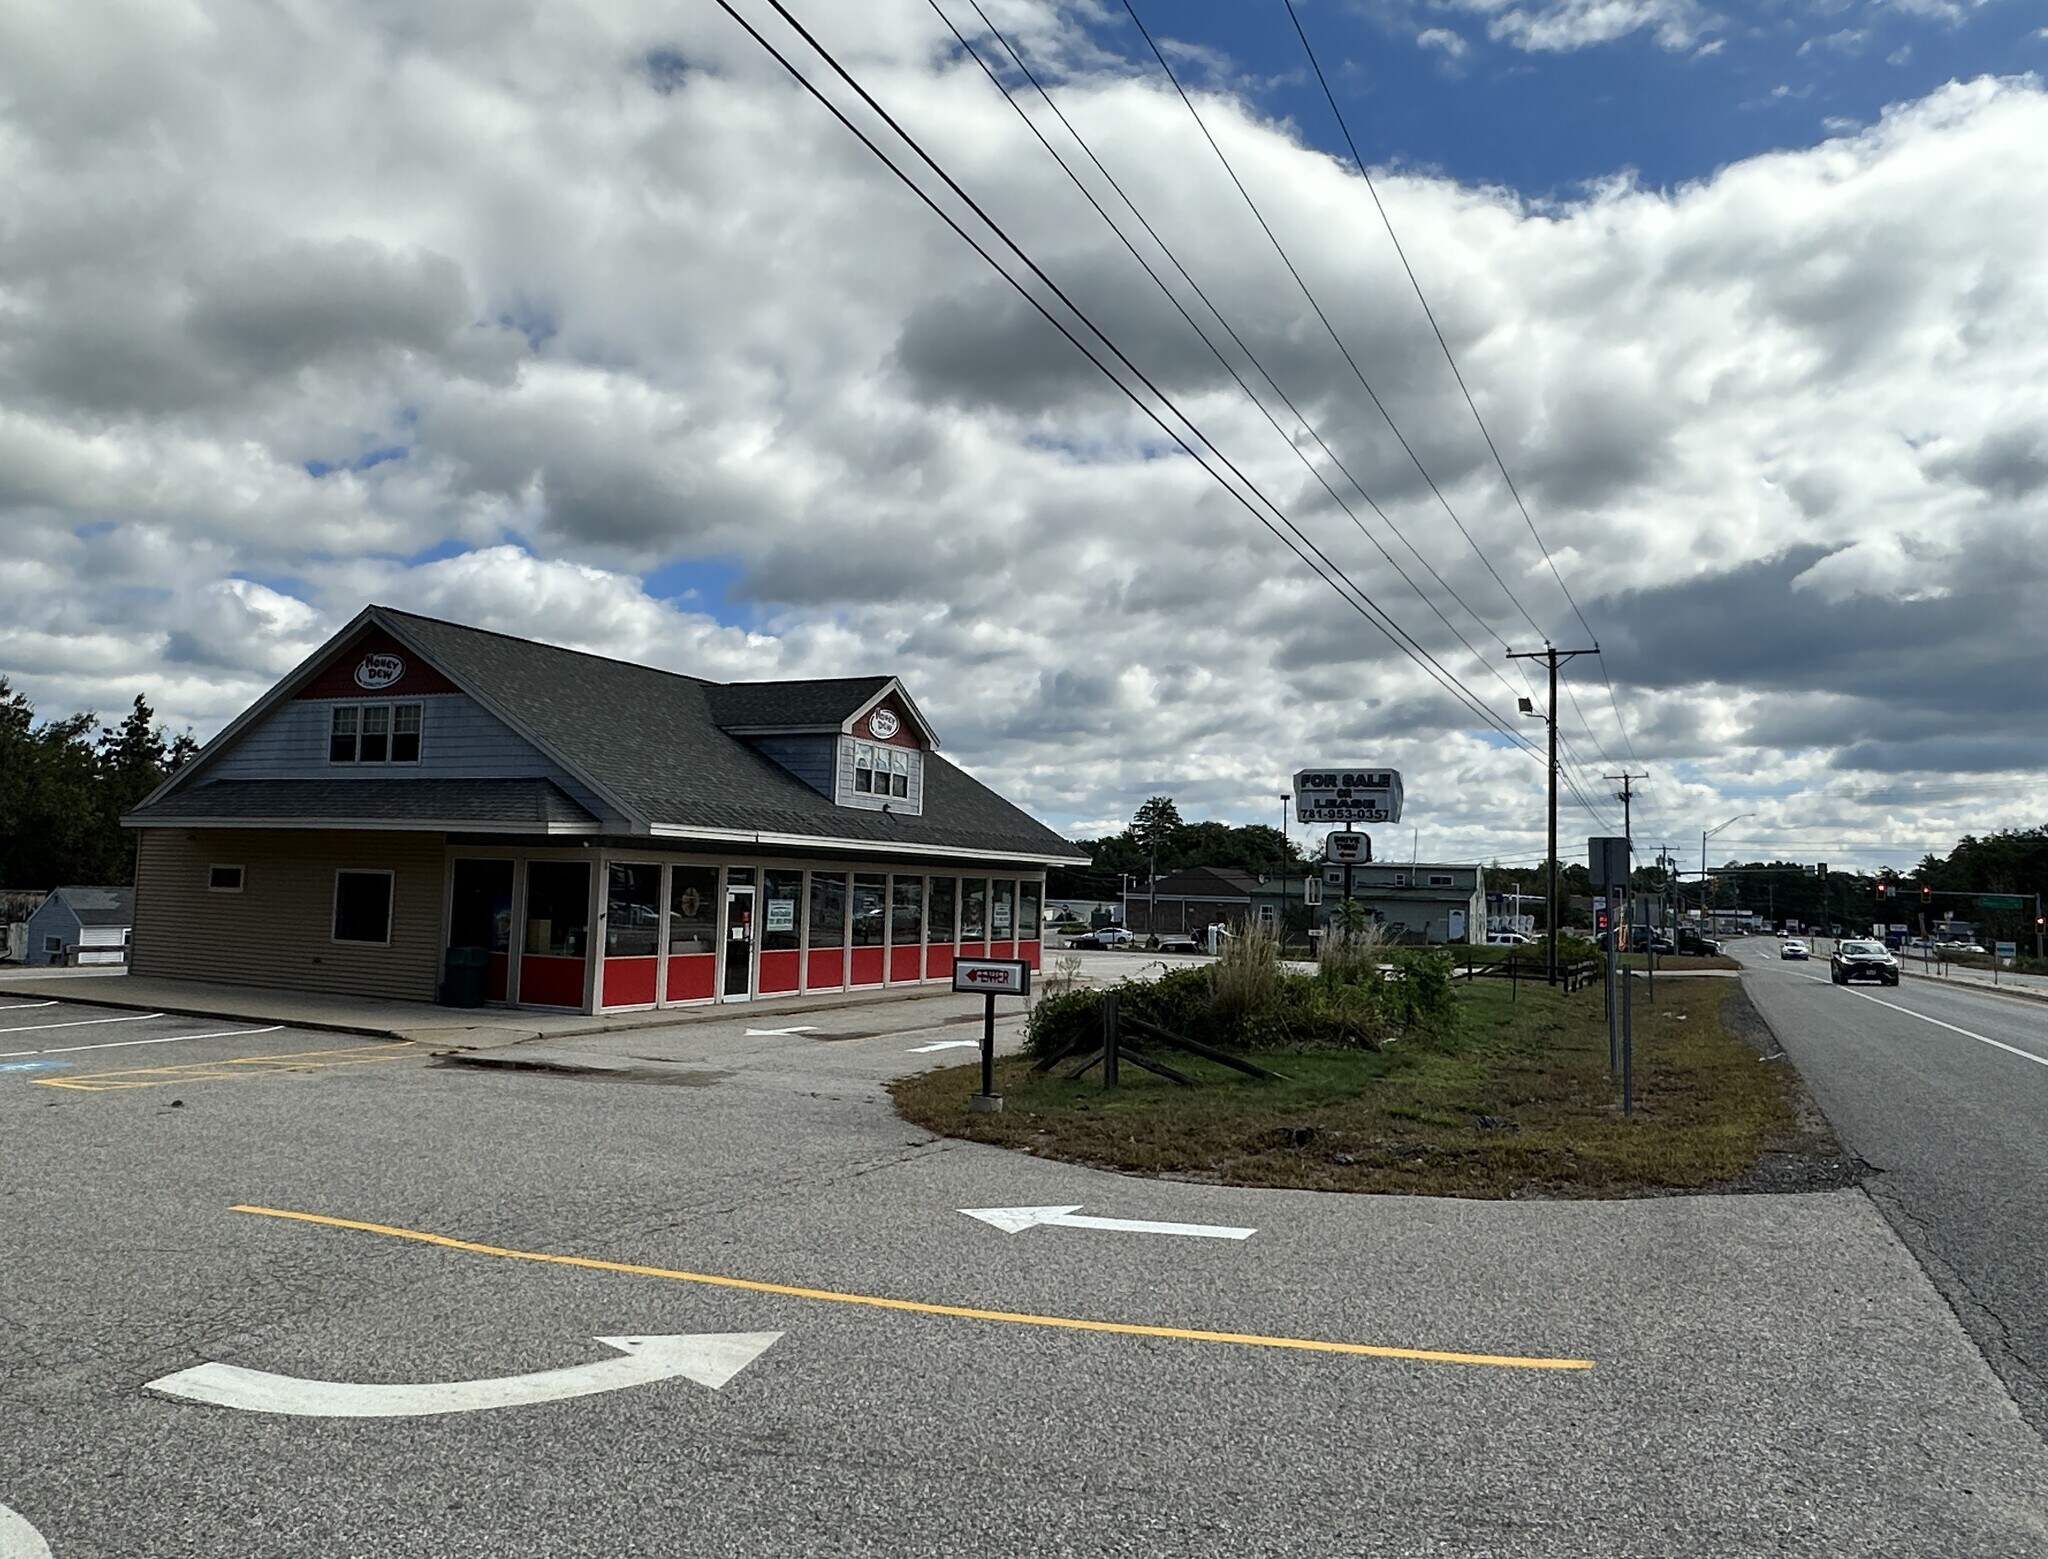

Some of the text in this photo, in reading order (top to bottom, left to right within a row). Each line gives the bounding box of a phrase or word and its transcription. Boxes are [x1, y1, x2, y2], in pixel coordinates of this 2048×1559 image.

[1301, 774, 1391, 788] FOR SALE
[1336, 788, 1352, 799] OR
[1314, 799, 1376, 809] LEASE
[1301, 809, 1389, 819] 781-953-0357
[1334, 836, 1360, 844] DRIVE
[1336, 843, 1358, 851] THRU
